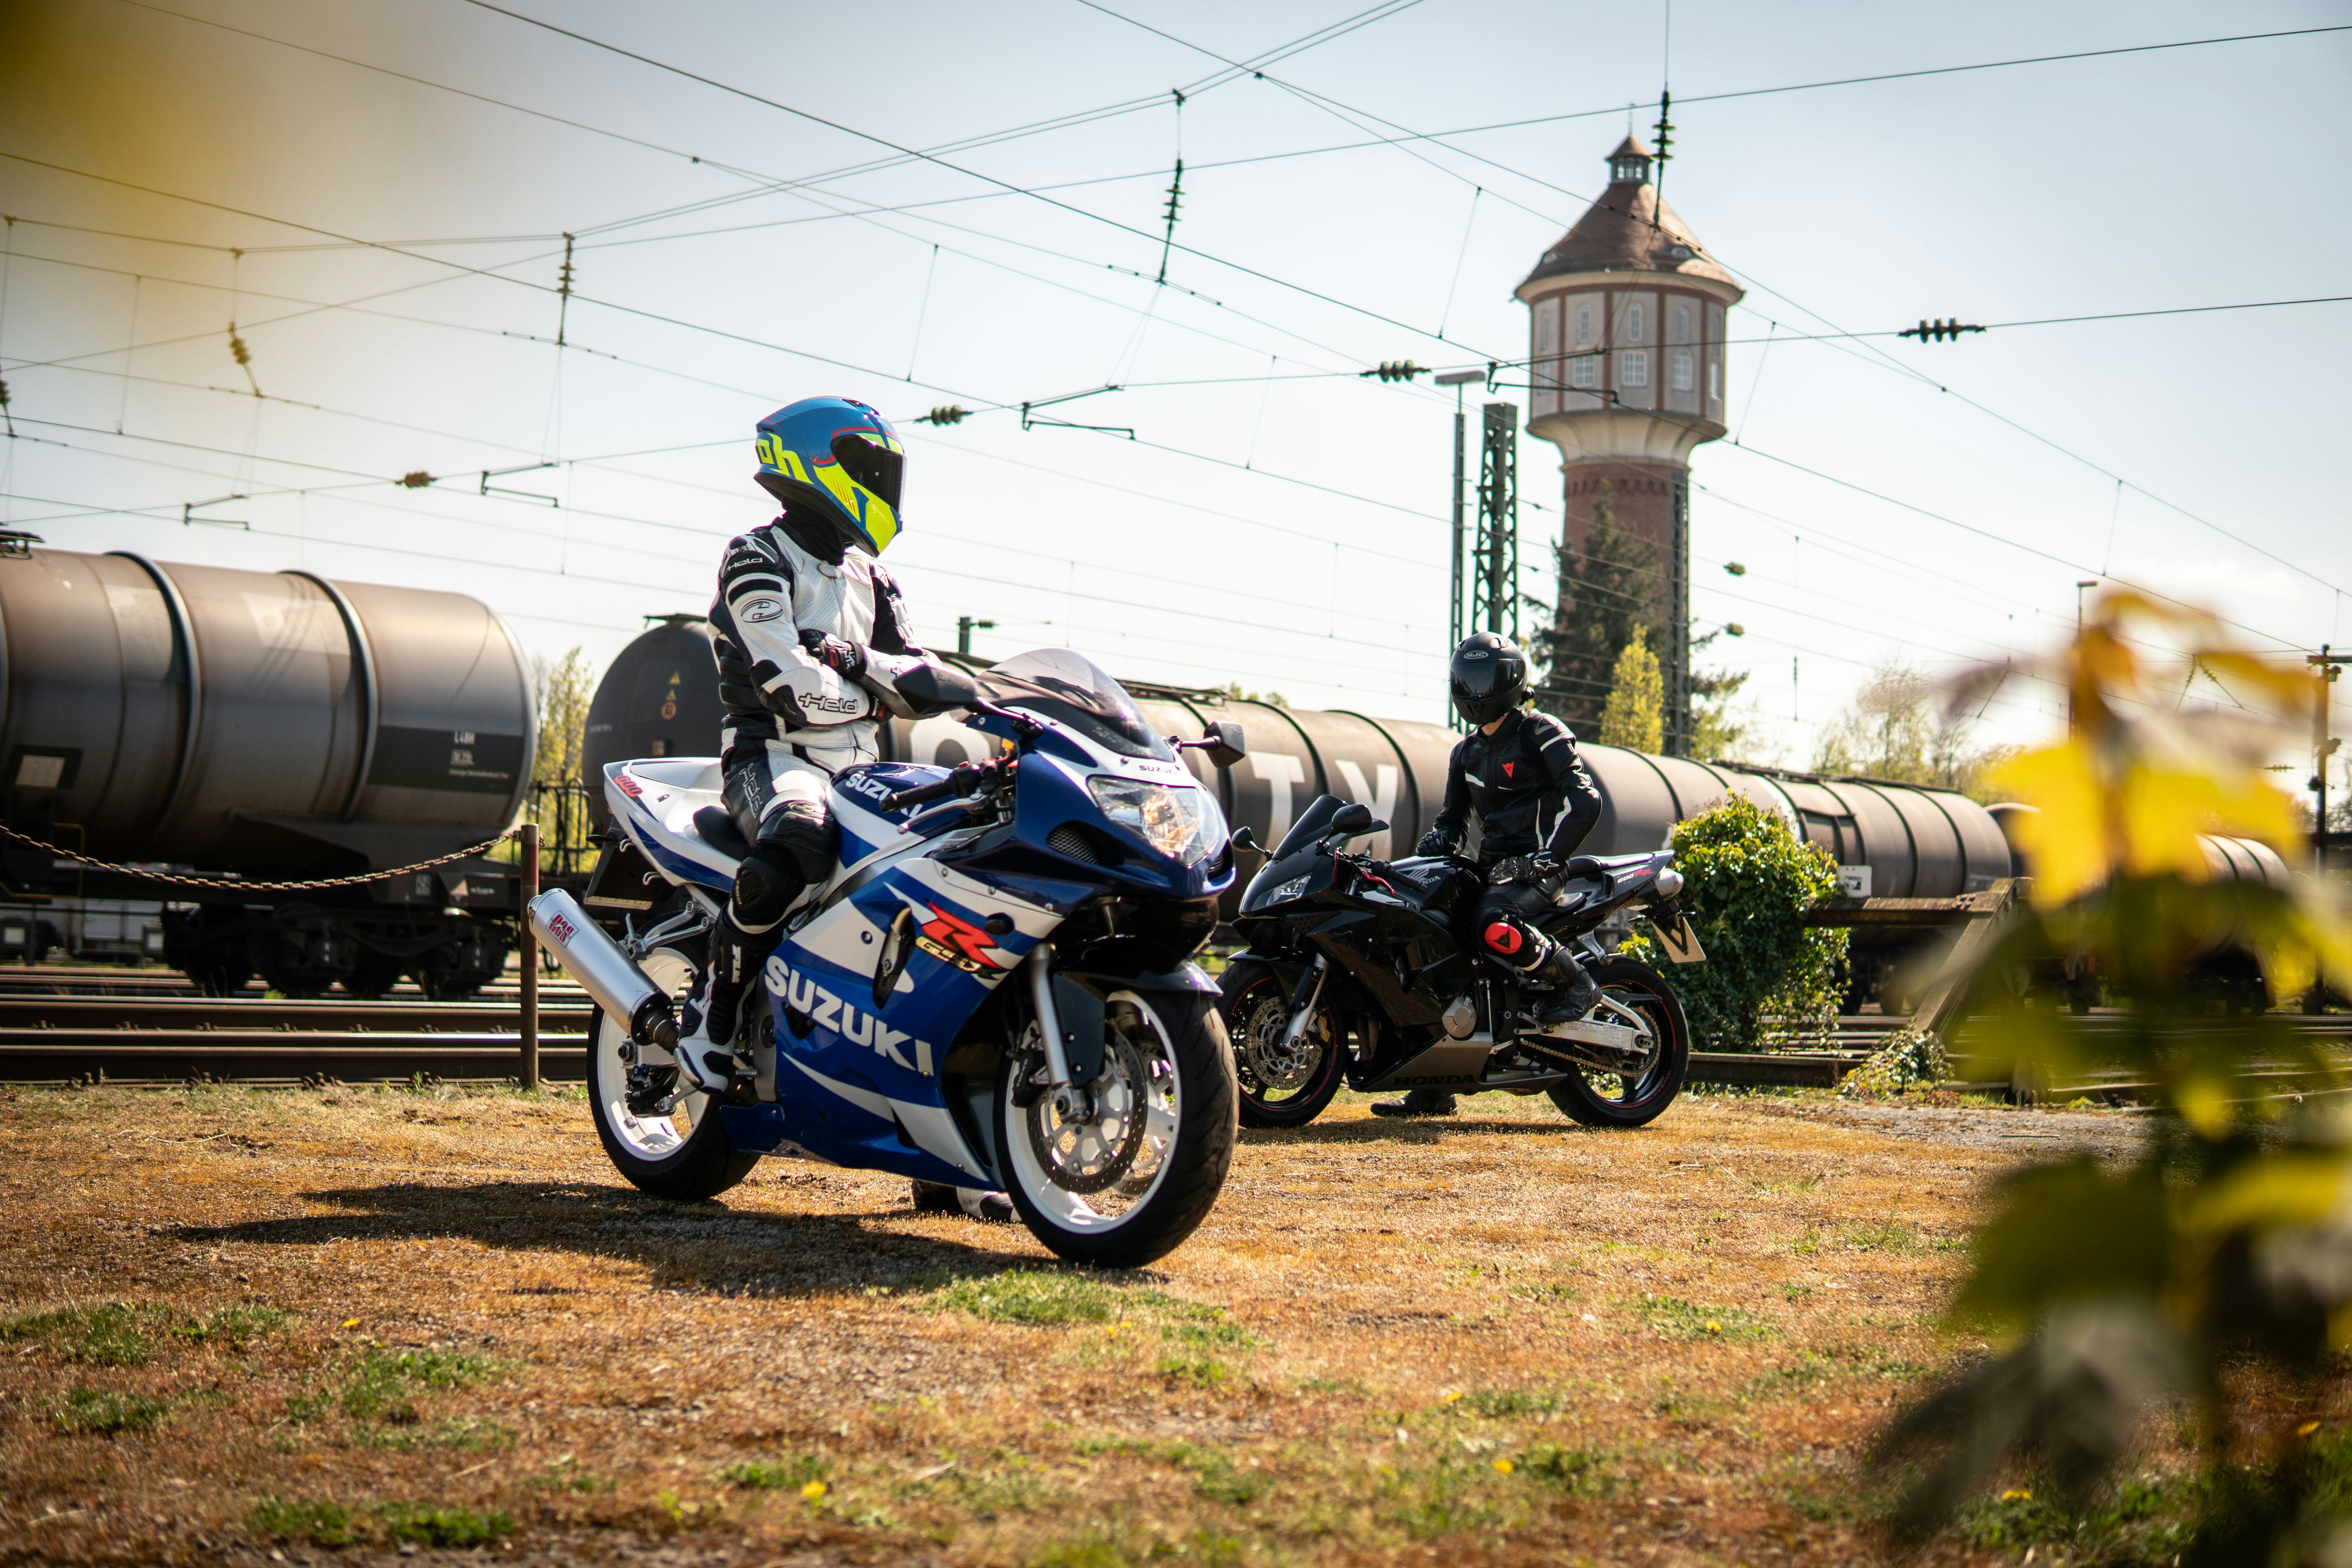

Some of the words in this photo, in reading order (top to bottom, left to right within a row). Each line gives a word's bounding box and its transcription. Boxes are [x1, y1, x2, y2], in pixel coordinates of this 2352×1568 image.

[726, 557, 763, 571] Held
[798, 692, 858, 714] Held
[614, 775, 643, 797] 600
[740, 763, 764, 819] Held
[764, 955, 934, 1077] SUZUKI
[1392, 1074, 1475, 1085] HONDA
